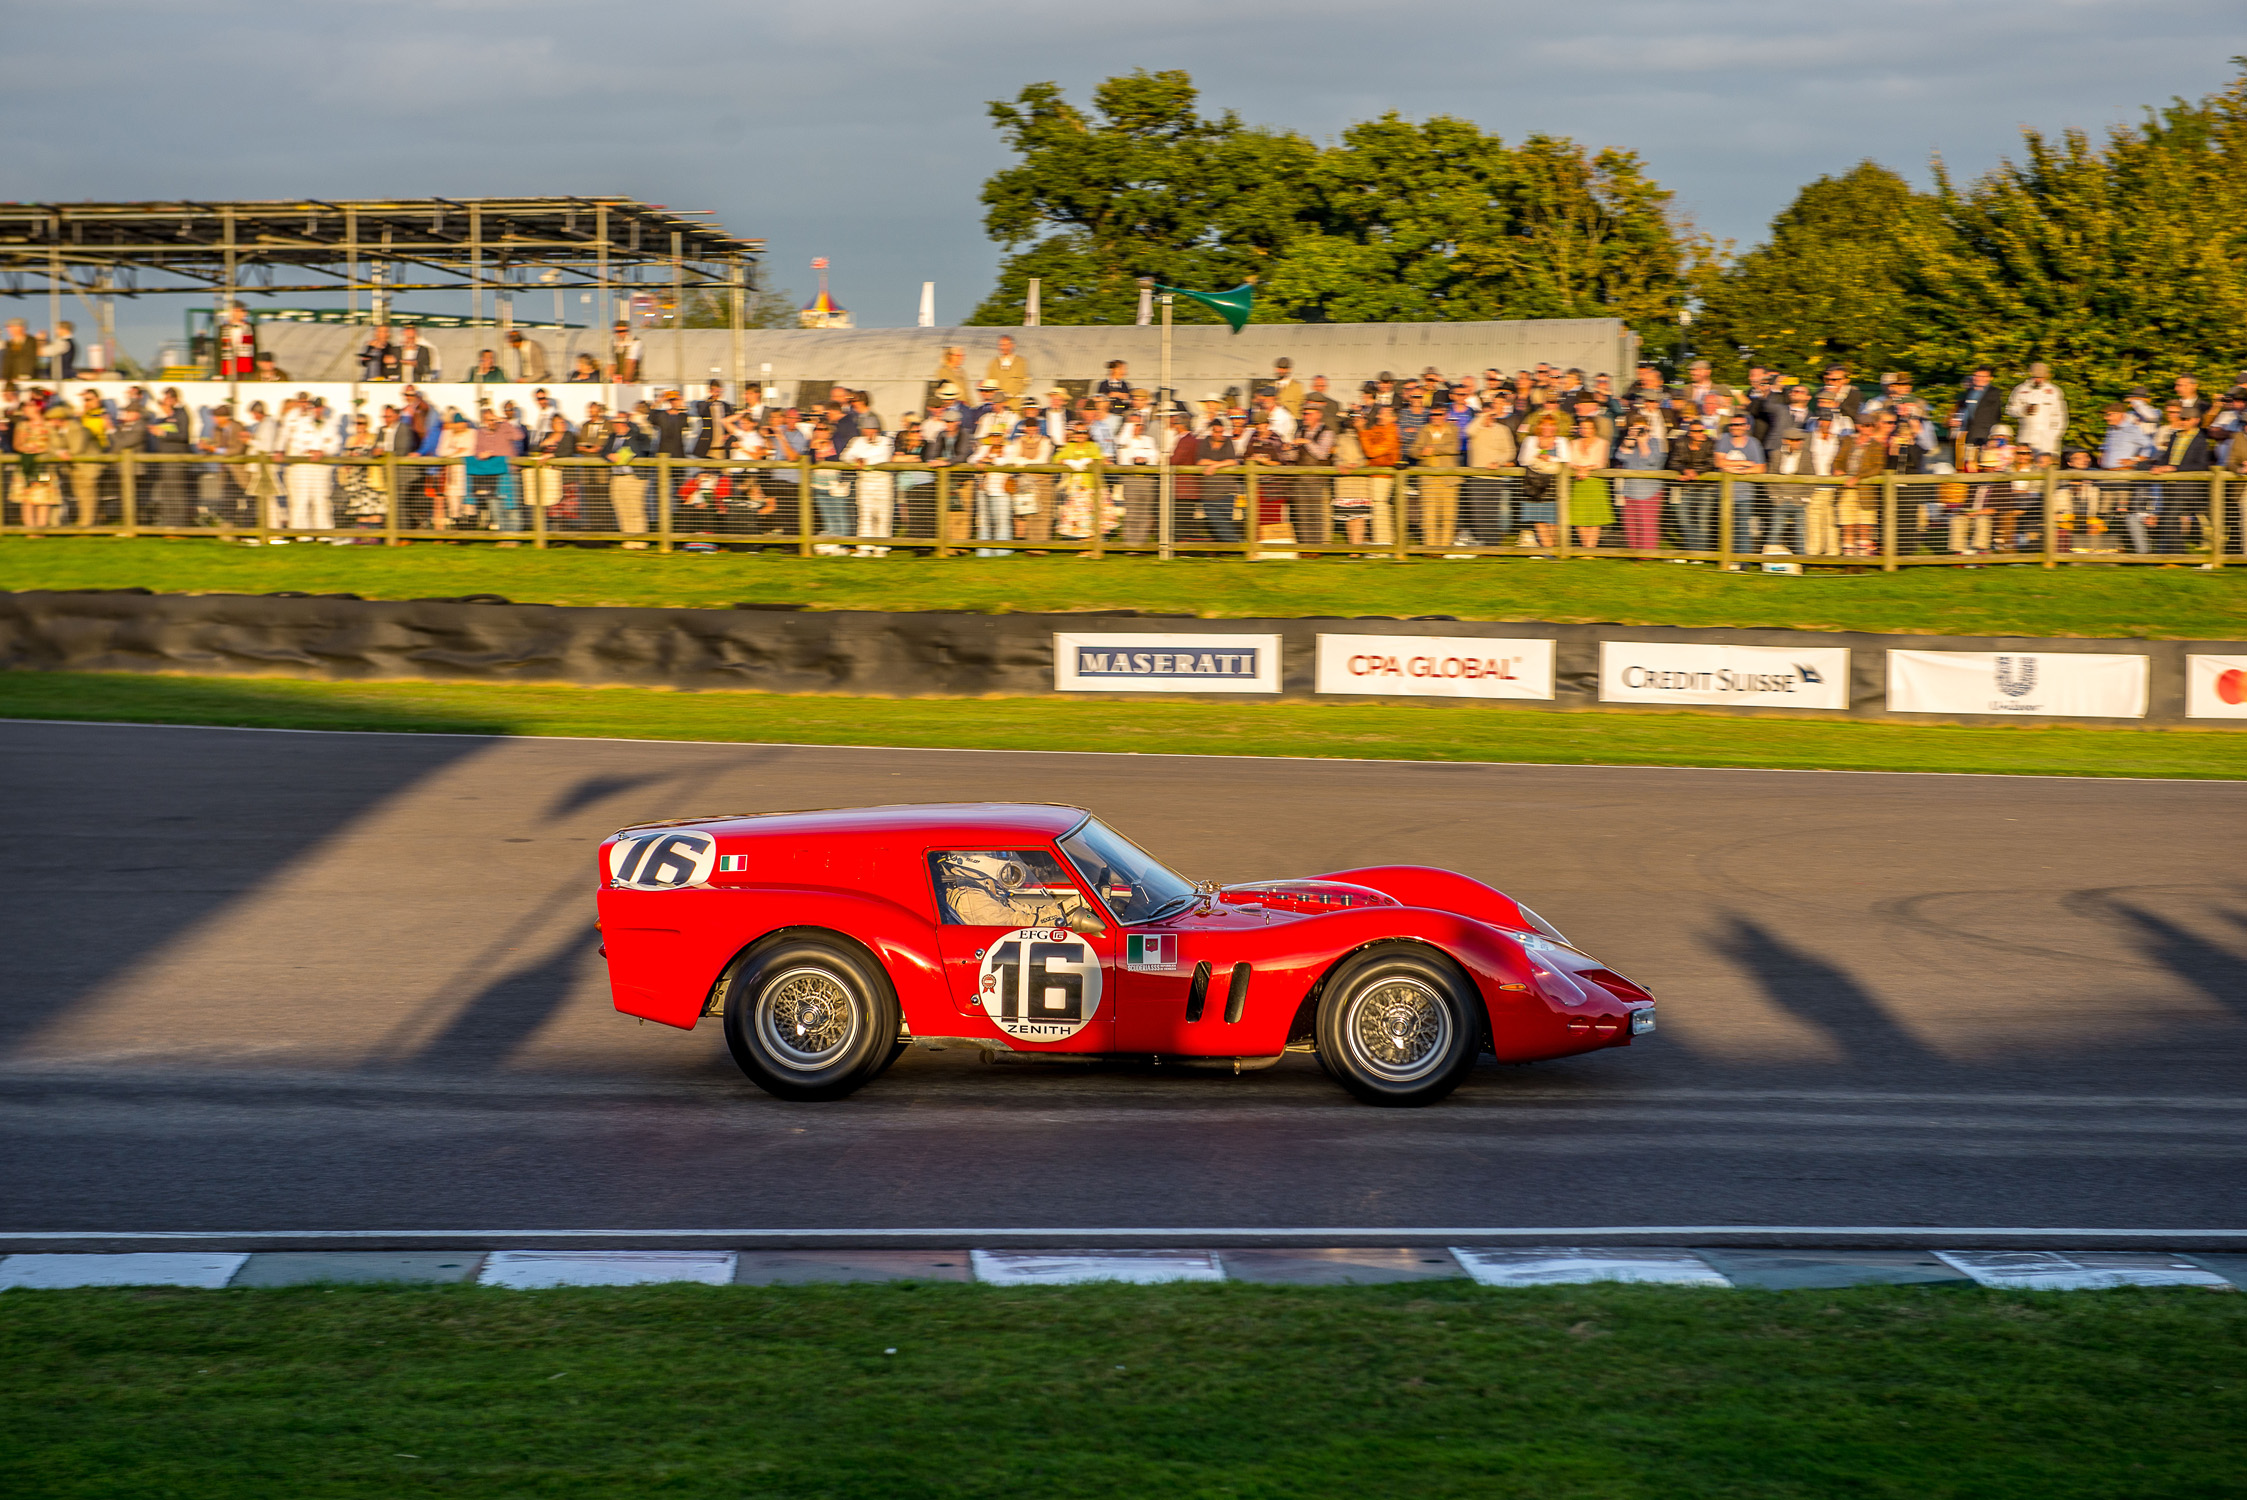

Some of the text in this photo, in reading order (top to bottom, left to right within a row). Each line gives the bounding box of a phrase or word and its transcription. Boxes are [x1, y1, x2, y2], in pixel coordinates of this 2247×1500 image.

[1079, 653, 1255, 675] MASERATI
[1347, 654, 1519, 680] CPA GLOBAL
[1621, 665, 1798, 693] CREDIT SUISSE
[617, 833, 711, 886] 16
[1018, 930, 1049, 940] EFG
[991, 941, 1085, 1024] 16
[1007, 1024, 1071, 1035] ZENITH
